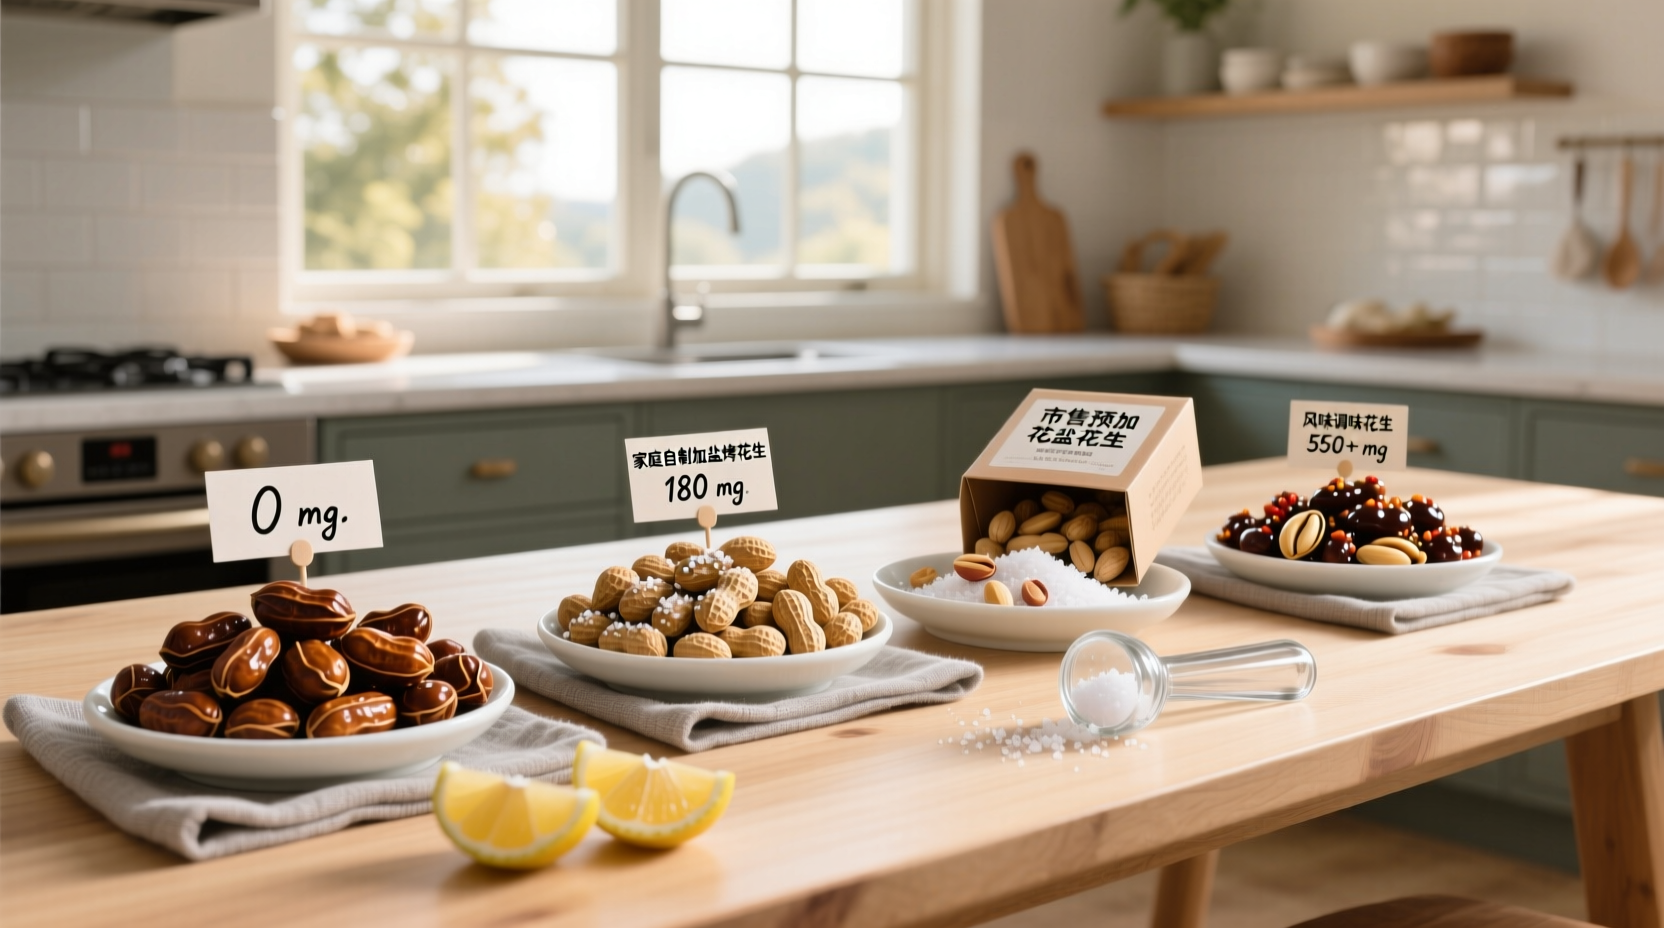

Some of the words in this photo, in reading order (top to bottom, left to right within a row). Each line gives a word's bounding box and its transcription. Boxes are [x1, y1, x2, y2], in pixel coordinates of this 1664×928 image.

[1040, 407, 1140, 430] 市售预加
[1303, 411, 1393, 432] 风味调味花生
[1027, 426, 1127, 449] 花盐花生
[1307, 434, 1358, 454] 550+
[1362, 444, 1388, 464] mg
[632, 441, 767, 469] 家庭自制加盐烤花生
[665, 473, 708, 503] 180
[251, 485, 282, 535] 0
[298, 506, 348, 541] mg.
